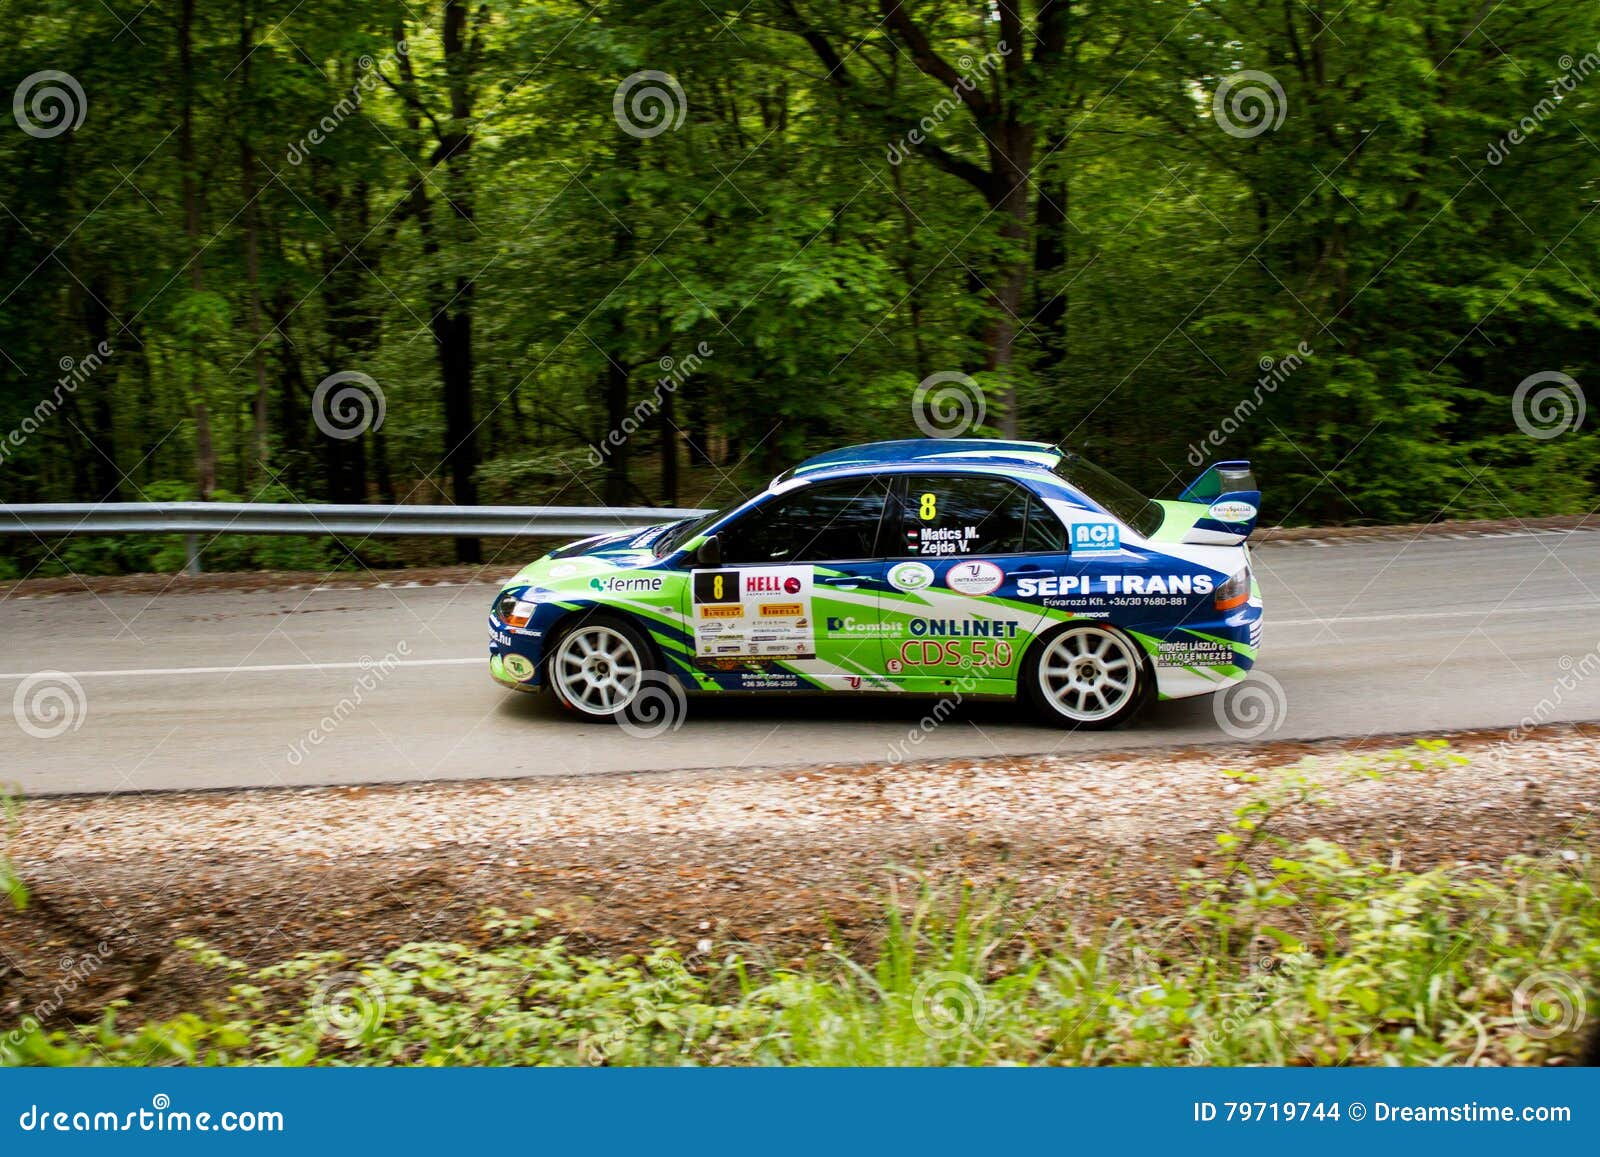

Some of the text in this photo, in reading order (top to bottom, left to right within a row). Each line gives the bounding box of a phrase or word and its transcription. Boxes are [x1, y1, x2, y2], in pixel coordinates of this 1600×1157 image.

[919, 493, 937, 521] 8
[920, 527, 980, 541] Matics M.
[920, 540, 970, 556] Zejda V.
[713, 575, 724, 600] 8
[747, 576, 781, 592] HELL
[1016, 575, 1214, 597] SEPI TRANS
[1089, 598, 1106, 606] Kft.
[1108, 597, 1141, 606] +36/30
[1144, 597, 1187, 605] 9680-881
[844, 616, 903, 631] Combit
[908, 618, 1019, 638] ONLINET
[901, 640, 1013, 668] CDS 5.0
